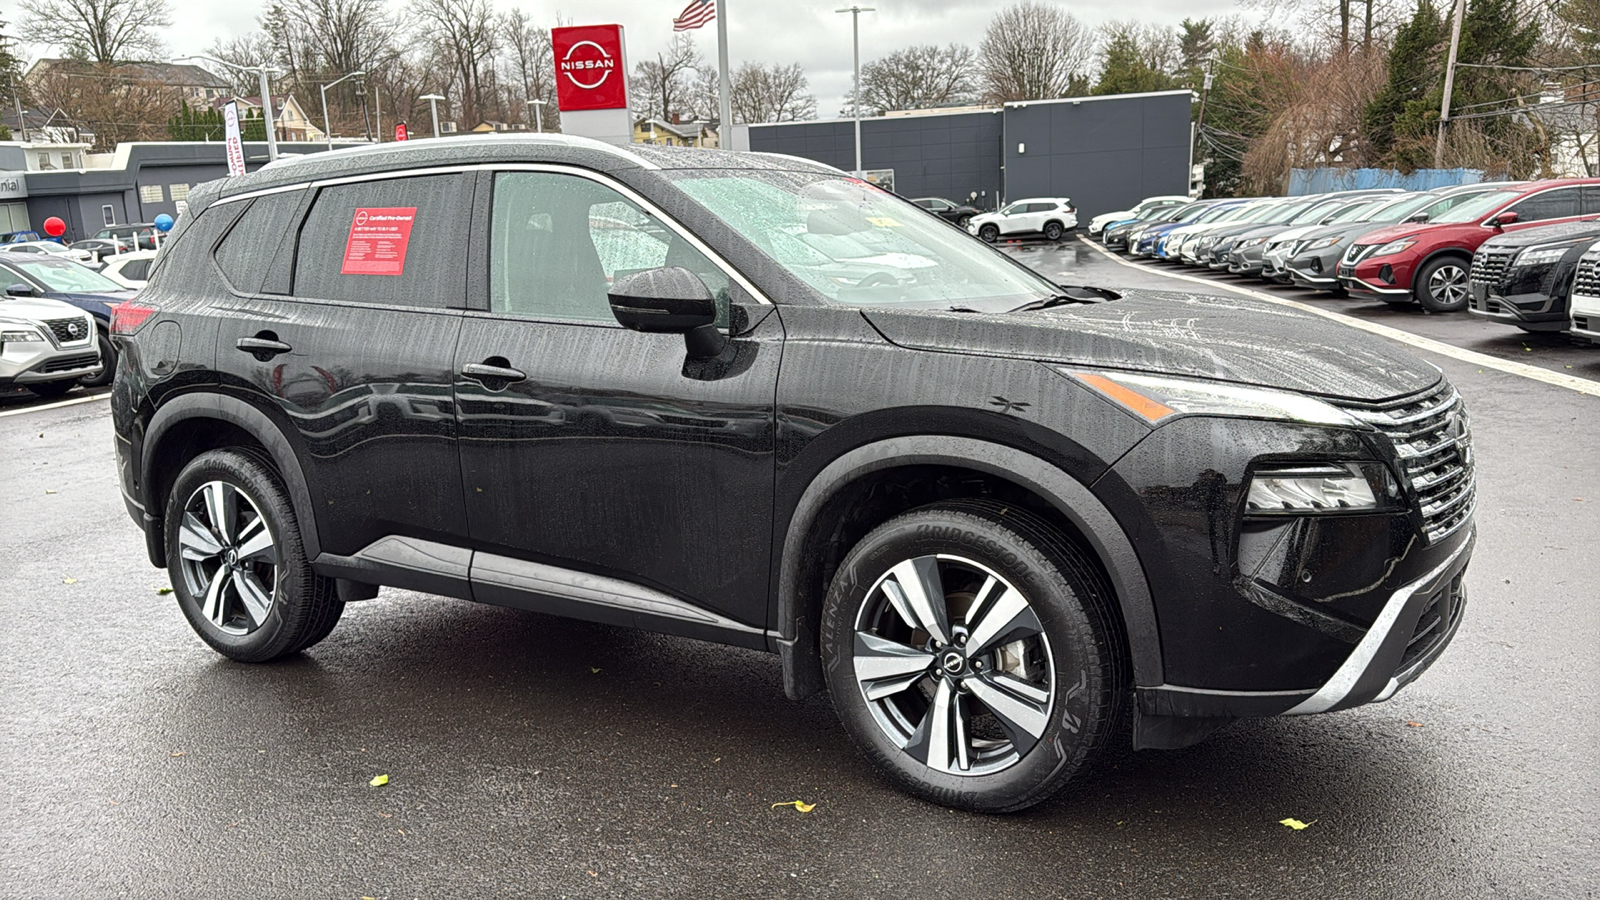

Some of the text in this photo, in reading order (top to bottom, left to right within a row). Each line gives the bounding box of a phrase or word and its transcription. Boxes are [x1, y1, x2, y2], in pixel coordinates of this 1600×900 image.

[561, 59, 613, 70] NISSAN
[916, 524, 1040, 585] BRIDGESTONE
[825, 581, 848, 653] ALENZA
